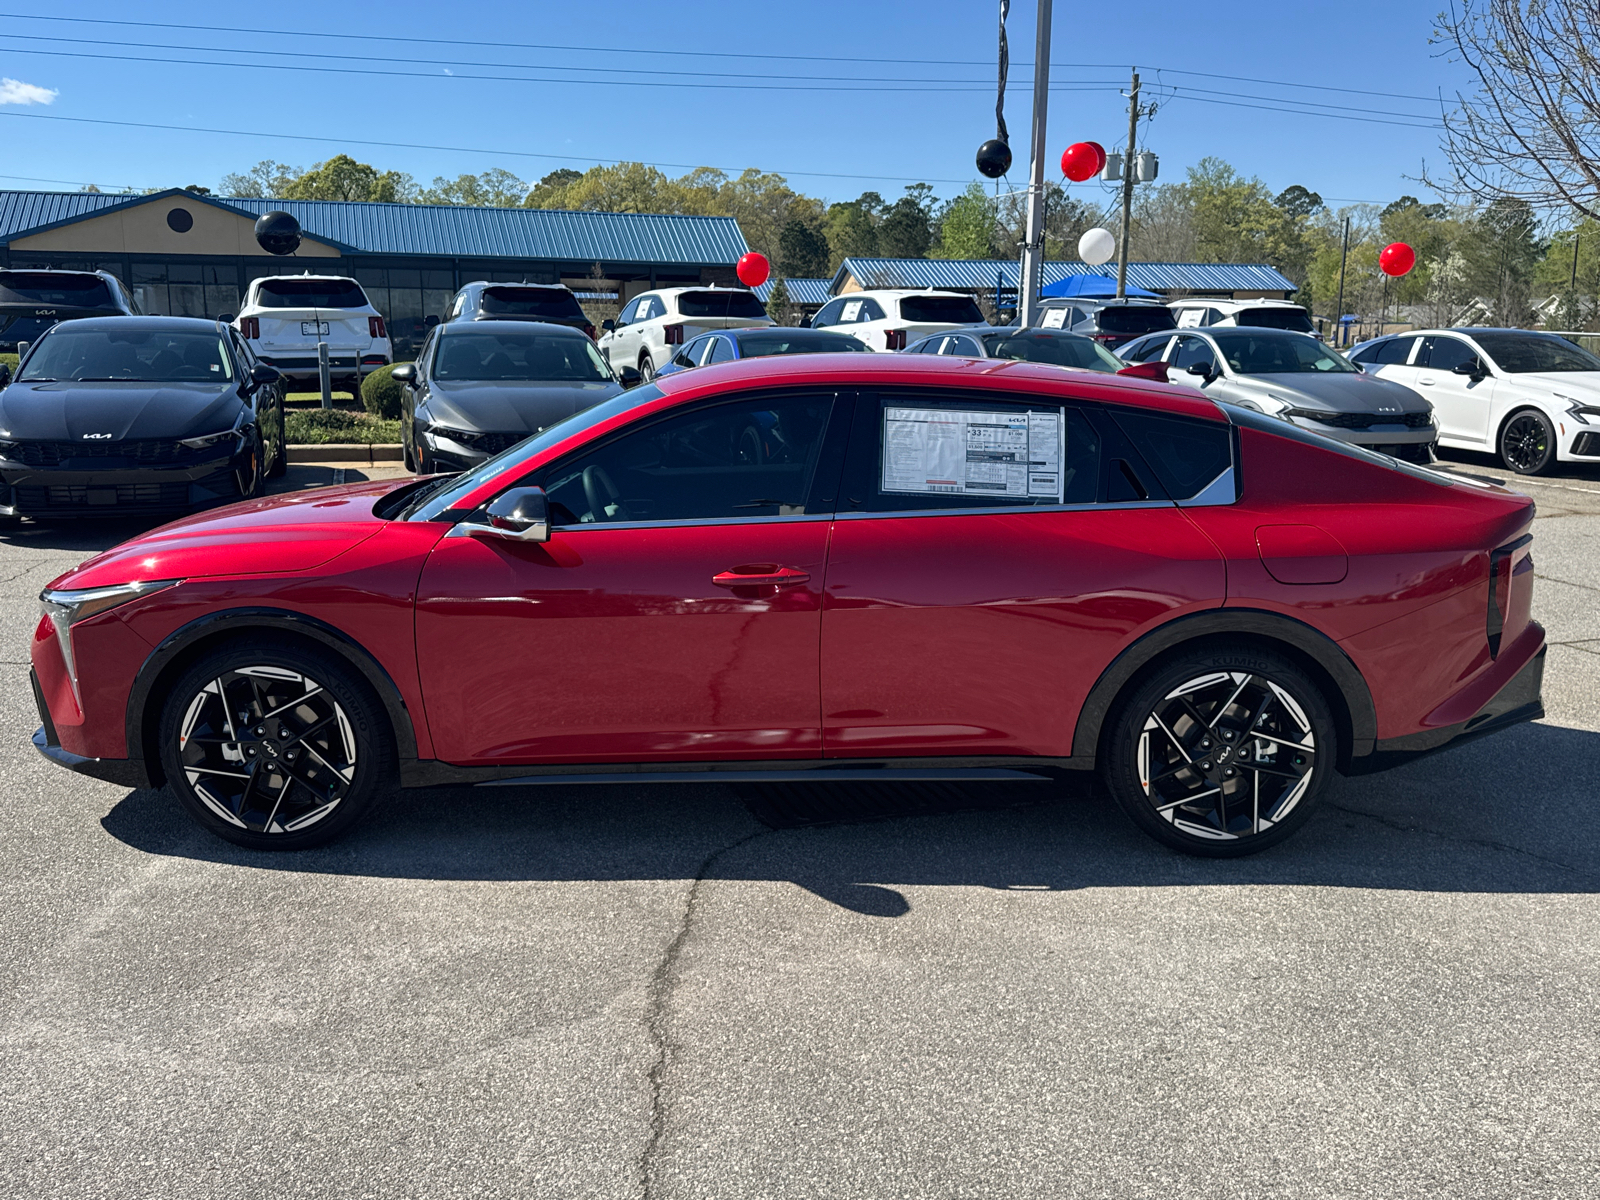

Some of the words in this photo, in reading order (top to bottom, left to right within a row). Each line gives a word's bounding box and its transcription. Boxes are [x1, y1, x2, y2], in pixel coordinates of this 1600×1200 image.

[1211, 656, 1269, 670] KUMHO
[334, 682, 367, 732] KUMHO
[262, 740, 278, 757] KIA
[1216, 746, 1232, 764] KIA
